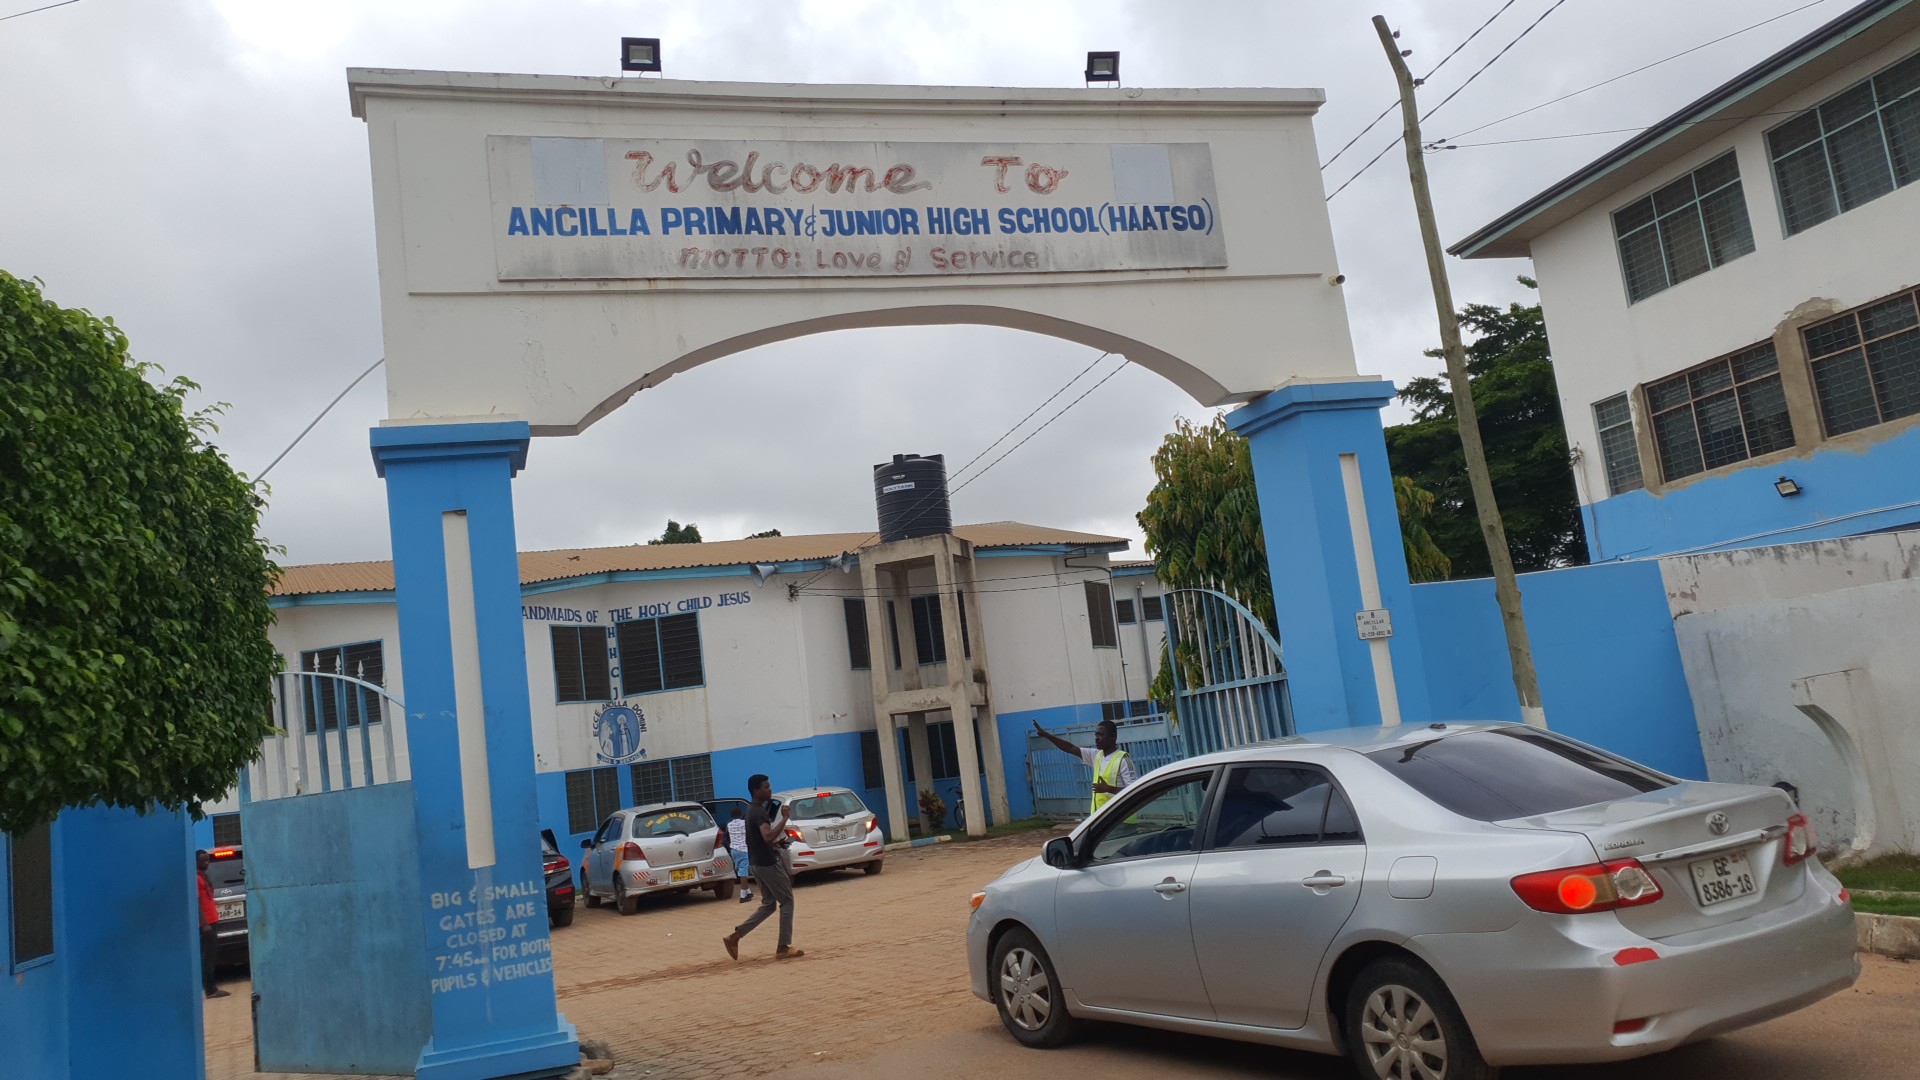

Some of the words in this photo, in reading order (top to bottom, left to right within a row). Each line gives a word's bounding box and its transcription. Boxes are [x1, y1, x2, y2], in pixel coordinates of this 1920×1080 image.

[624, 148, 934, 195] Welcome
[507, 206, 651, 237] ANCILLA
[660, 206, 804, 236] PRIMARY
[819, 207, 920, 237] JUNIOR
[926, 206, 991, 236] HIGH
[998, 206, 1100, 235] SCHOOL
[586, 610, 599, 623] OF
[608, 607, 633, 622] THE
[639, 601, 671, 618] HOLY
[677, 596, 712, 612] CHILD
[717, 591, 751, 607] JESUS
[632, 703, 647, 733] DOMINI
[1713, 857, 1731, 877] GE
[431, 891, 462, 909] BIG
[484, 880, 539, 901] SMALL
[1702, 873, 1753, 902] 8386-18
[441, 909, 496, 930] GATES
[505, 901, 536, 921] ARE
[446, 927, 507, 949] CLOSED
[511, 922, 528, 939] AT
[492, 944, 518, 962] FOR
[520, 938, 551, 957] BOTH
[431, 972, 477, 994] PUPILS
